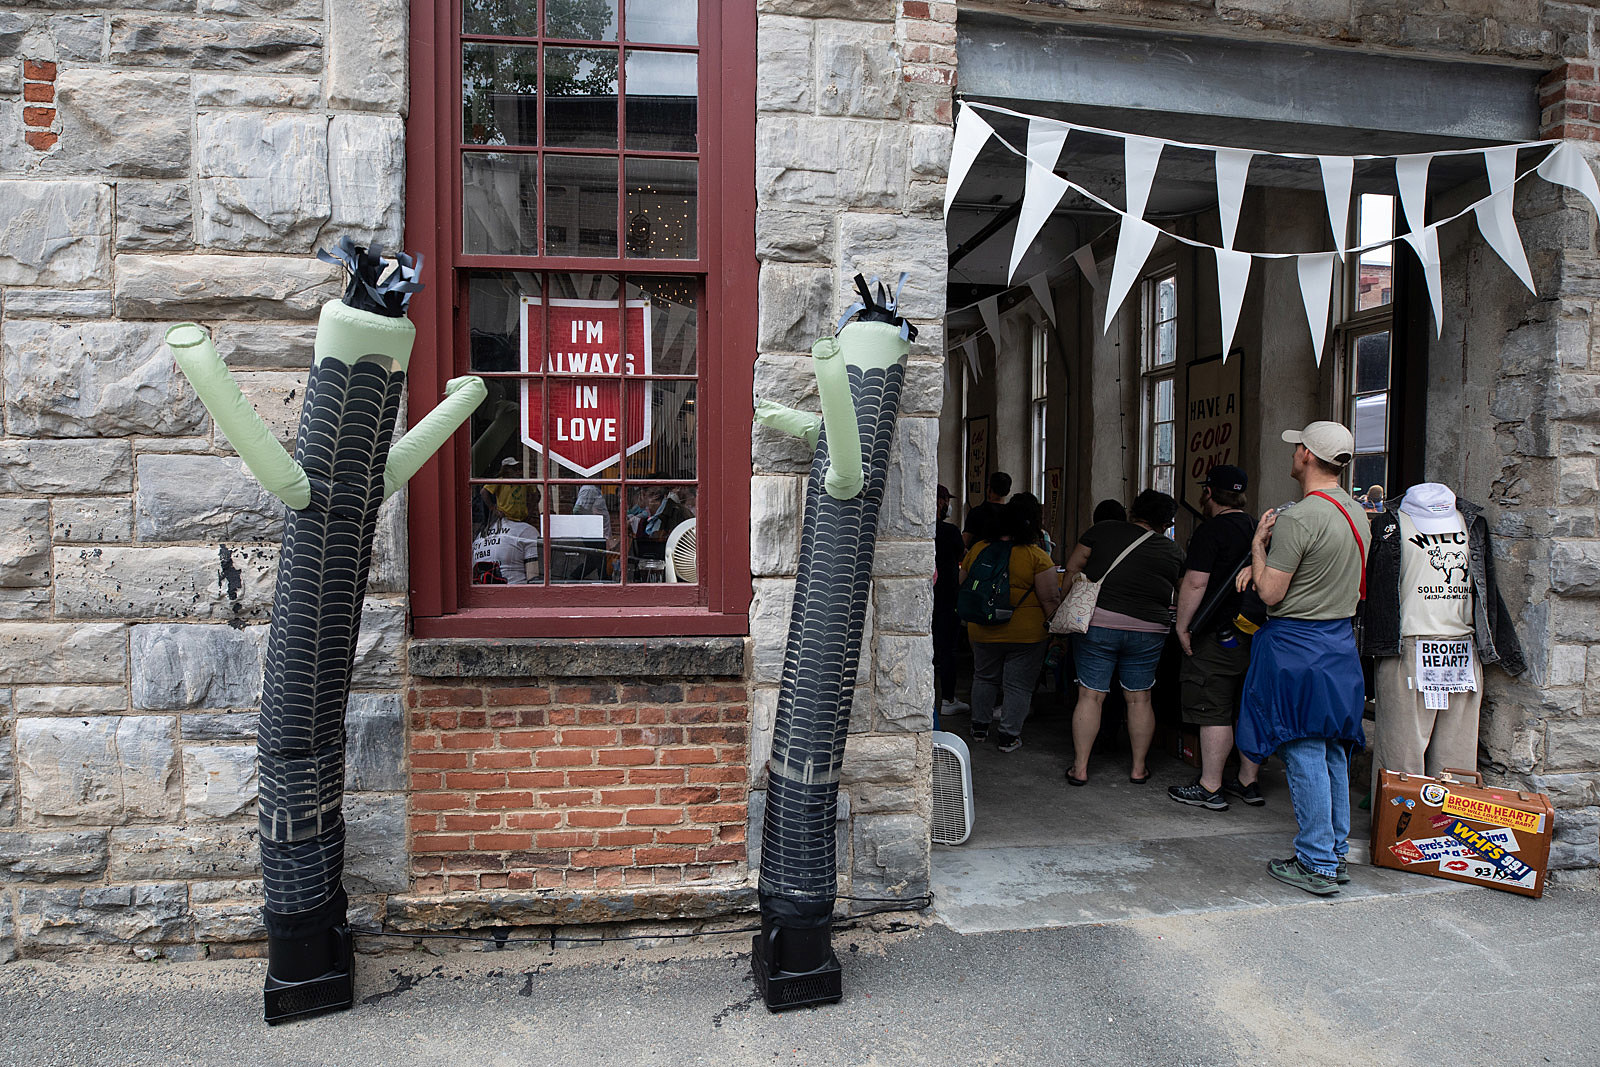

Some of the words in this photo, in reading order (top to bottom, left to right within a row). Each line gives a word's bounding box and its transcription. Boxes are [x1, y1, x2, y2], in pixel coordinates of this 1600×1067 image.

[571, 320, 603, 344] I'M
[575, 385, 598, 408] IN
[1190, 396, 1220, 421] HAVE
[1226, 393, 1235, 414] A
[557, 418, 617, 442] LOVE
[1190, 423, 1232, 453] GOOD
[1408, 531, 1466, 550] WILC
[1417, 585, 1444, 594] SOLID
[1422, 642, 1469, 654] BROKEN
[1422, 655, 1470, 668] HEART?
[1448, 795, 1492, 814] BROKEN
[1494, 806, 1536, 825] HEART?
[1482, 812, 1499, 820] LOVE
[1453, 821, 1505, 860] WHFS
[1500, 855, 1530, 876] 99.1
[1474, 867, 1491, 877] 93
